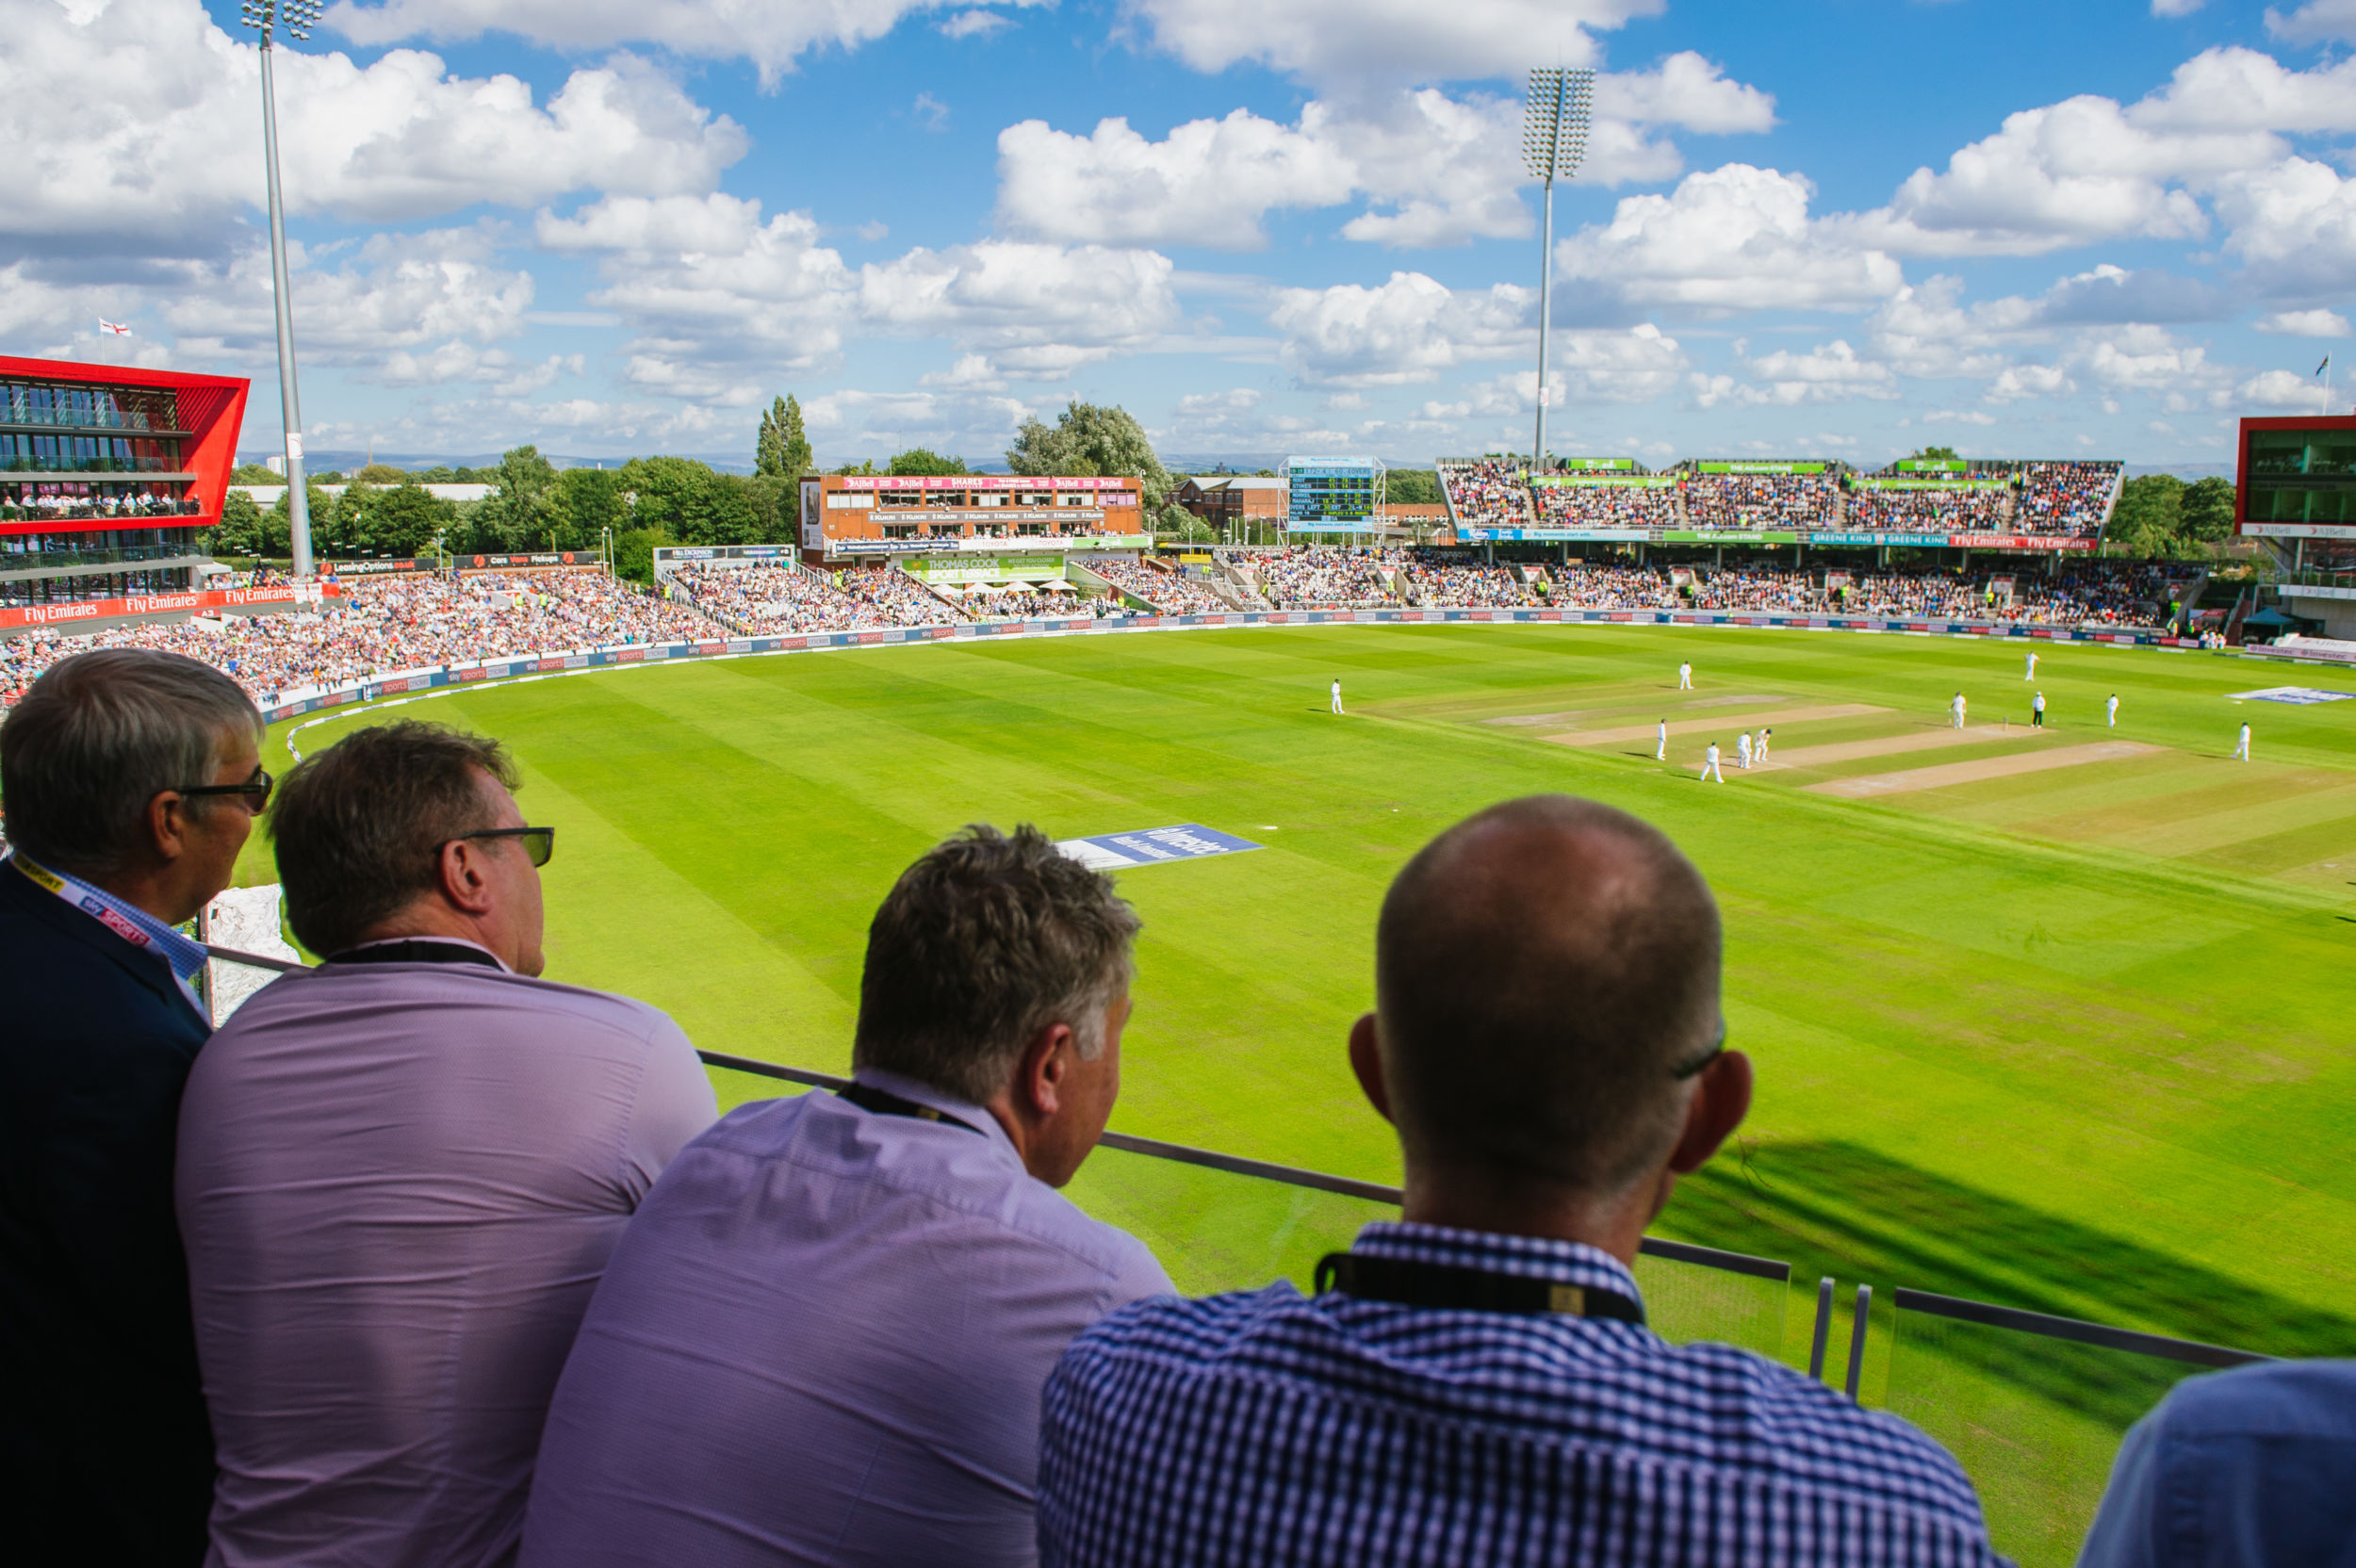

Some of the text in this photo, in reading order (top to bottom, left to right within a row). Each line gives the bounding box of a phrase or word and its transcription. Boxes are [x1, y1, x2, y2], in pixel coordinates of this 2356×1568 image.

[1850, 534, 1873, 543] KING
[1888, 535, 1922, 544] GREENE
[1955, 536, 2016, 547] Fly Emirates
[2027, 537, 2089, 548] Fly Emirates
[531, 555, 558, 564] Pickups
[928, 558, 1000, 569] THOMAS COOK
[928, 569, 959, 580] SPORT
[226, 590, 244, 604] Fly
[246, 588, 294, 601] Emirates
[126, 594, 197, 612] Fly Emirates
[25, 604, 97, 623] Fly Emirates
[782, 639, 806, 647] sports
[847, 635, 859, 644] sky
[859, 634, 882, 643] sports
[688, 646, 700, 656] sky
[701, 645, 726, 654] sports
[2309, 649, 2347, 660] Investec
[605, 653, 617, 662] sky
[619, 651, 643, 661] sports
[526, 662, 538, 671] sky
[540, 660, 564, 670] sports
[449, 672, 460, 682] sky
[462, 669, 486, 679] sports
[384, 681, 407, 693] sports
[83, 897, 147, 944] sky SPORTS
